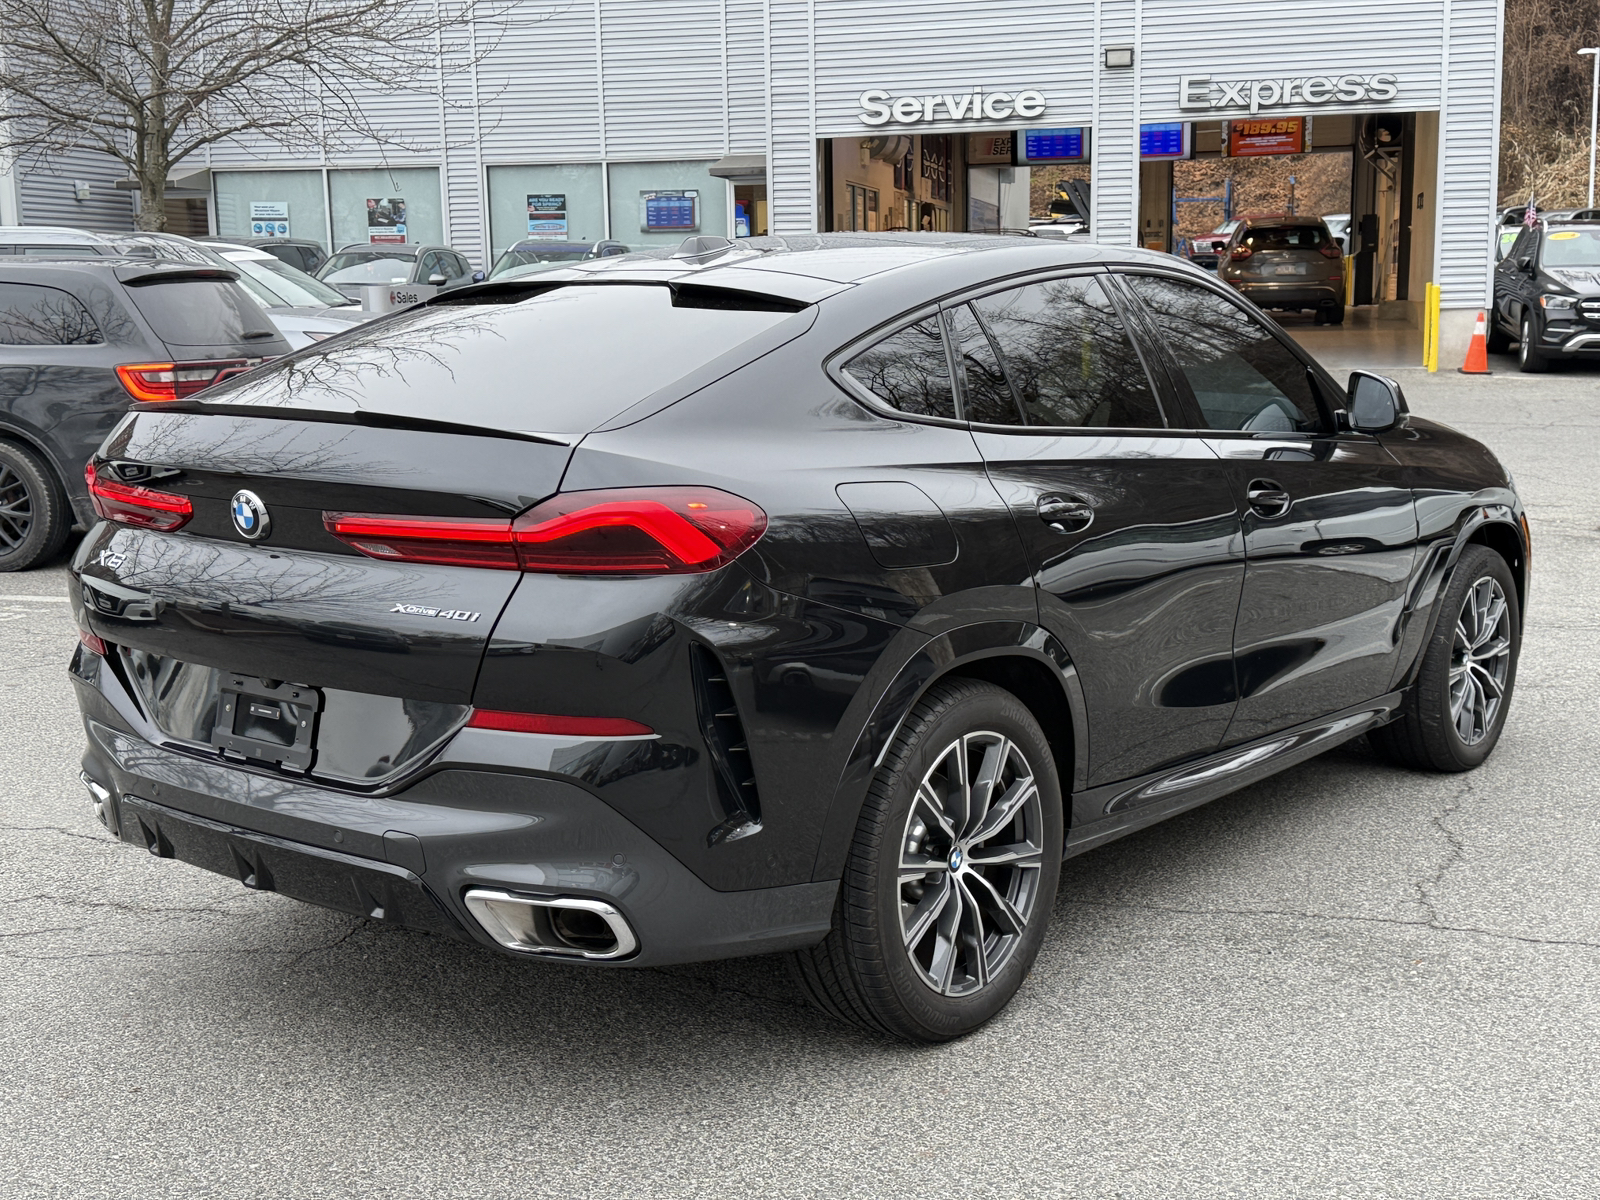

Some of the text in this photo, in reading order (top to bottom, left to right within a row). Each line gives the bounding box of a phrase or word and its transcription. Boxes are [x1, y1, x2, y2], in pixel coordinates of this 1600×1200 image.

[1179, 73, 1398, 114] Express
[857, 86, 1046, 125] Service
[1236, 121, 1299, 135] $189.95
[396, 291, 419, 304] Sales
[90, 549, 127, 569] X6
